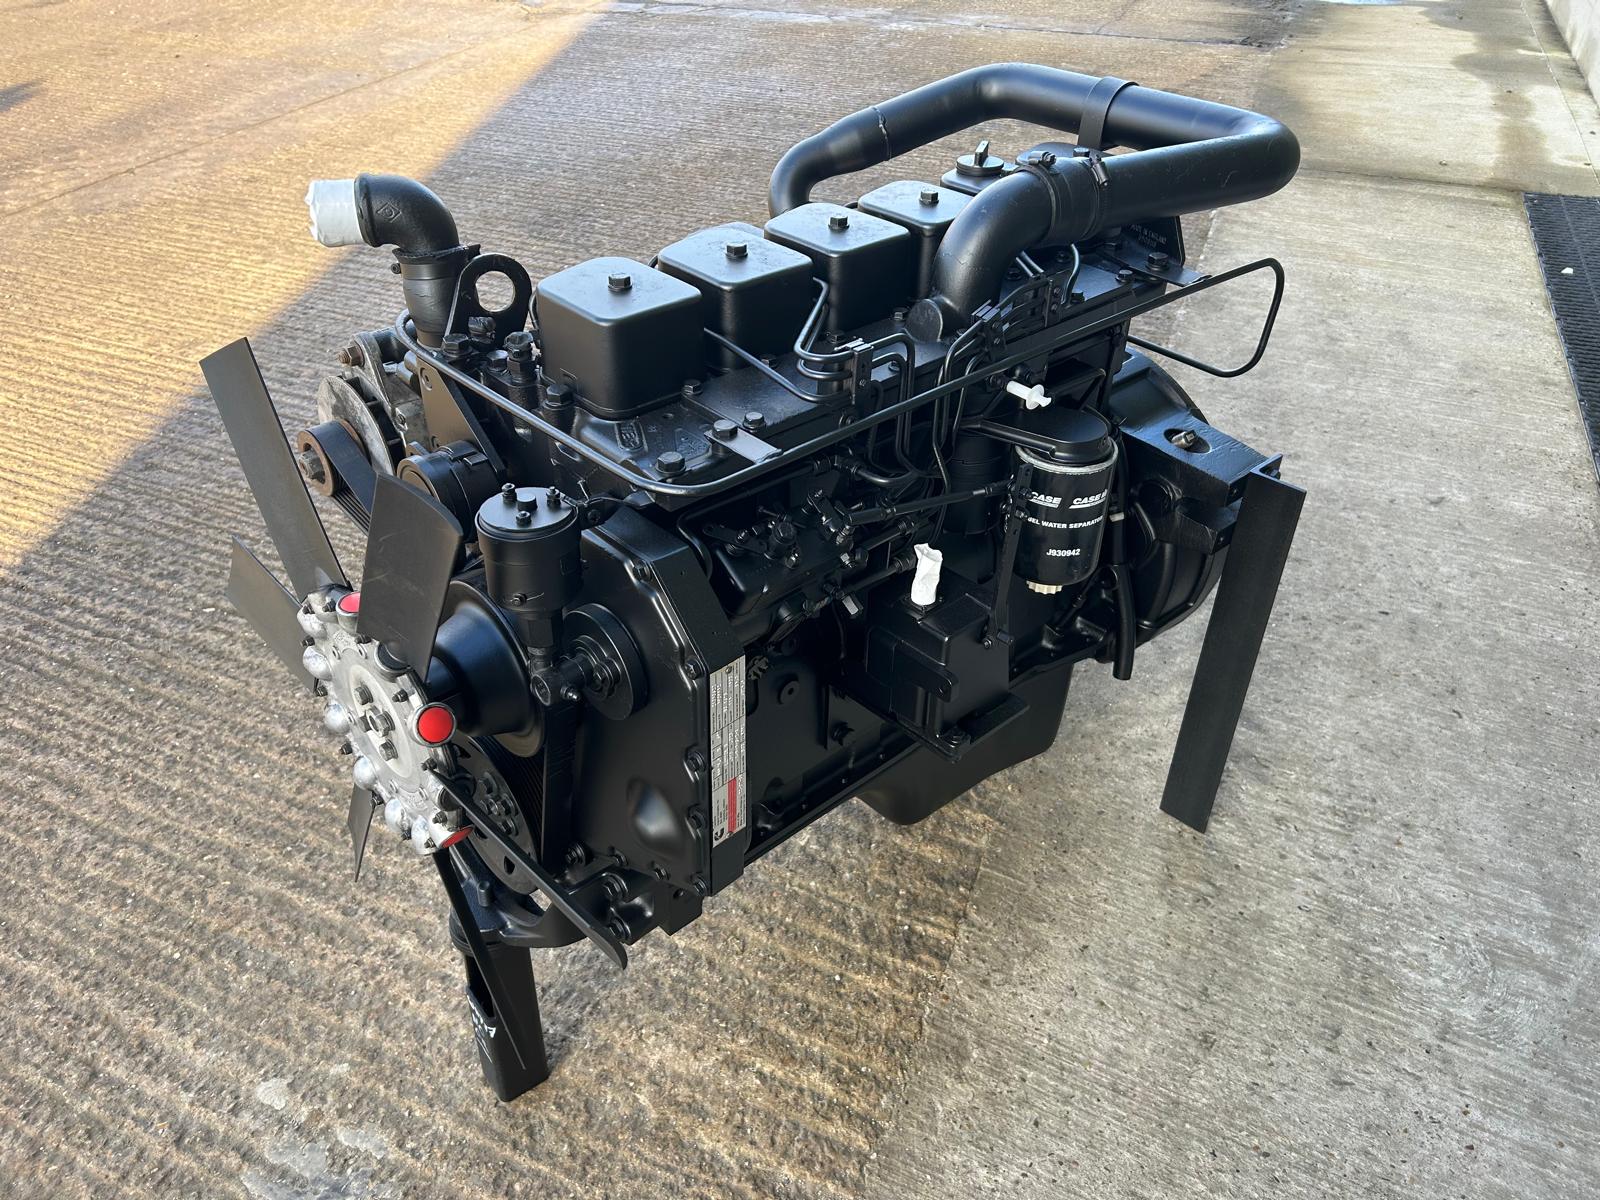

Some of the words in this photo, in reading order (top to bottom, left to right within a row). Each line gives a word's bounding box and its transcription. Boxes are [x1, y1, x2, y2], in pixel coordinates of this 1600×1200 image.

[1031, 491, 1062, 504] CASE
[1072, 493, 1101, 505] CASE
[1027, 516, 1040, 525] UEL
[1041, 520, 1067, 529] WATER
[1046, 548, 1081, 557] J930942
